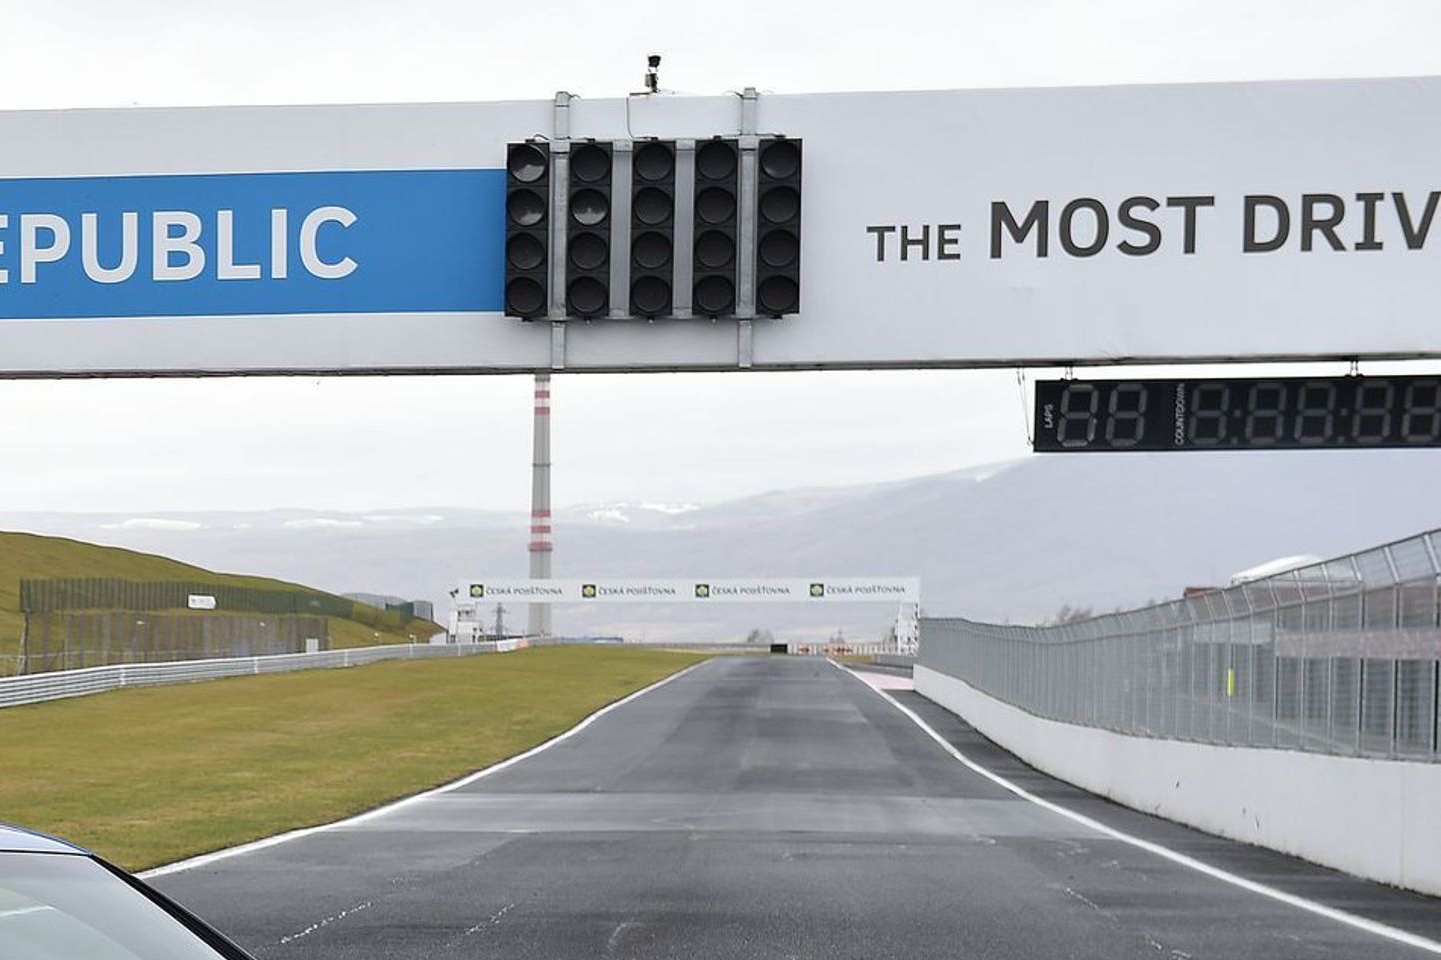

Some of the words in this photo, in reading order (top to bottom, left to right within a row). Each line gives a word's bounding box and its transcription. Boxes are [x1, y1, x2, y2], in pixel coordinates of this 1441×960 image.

[866, 223, 962, 262] THE
[989, 195, 1215, 259] MOST
[1243, 190, 1441, 254] DRIV
[1044, 403, 1055, 429] LAPS
[1174, 382, 1186, 446] COUNTDOWN
